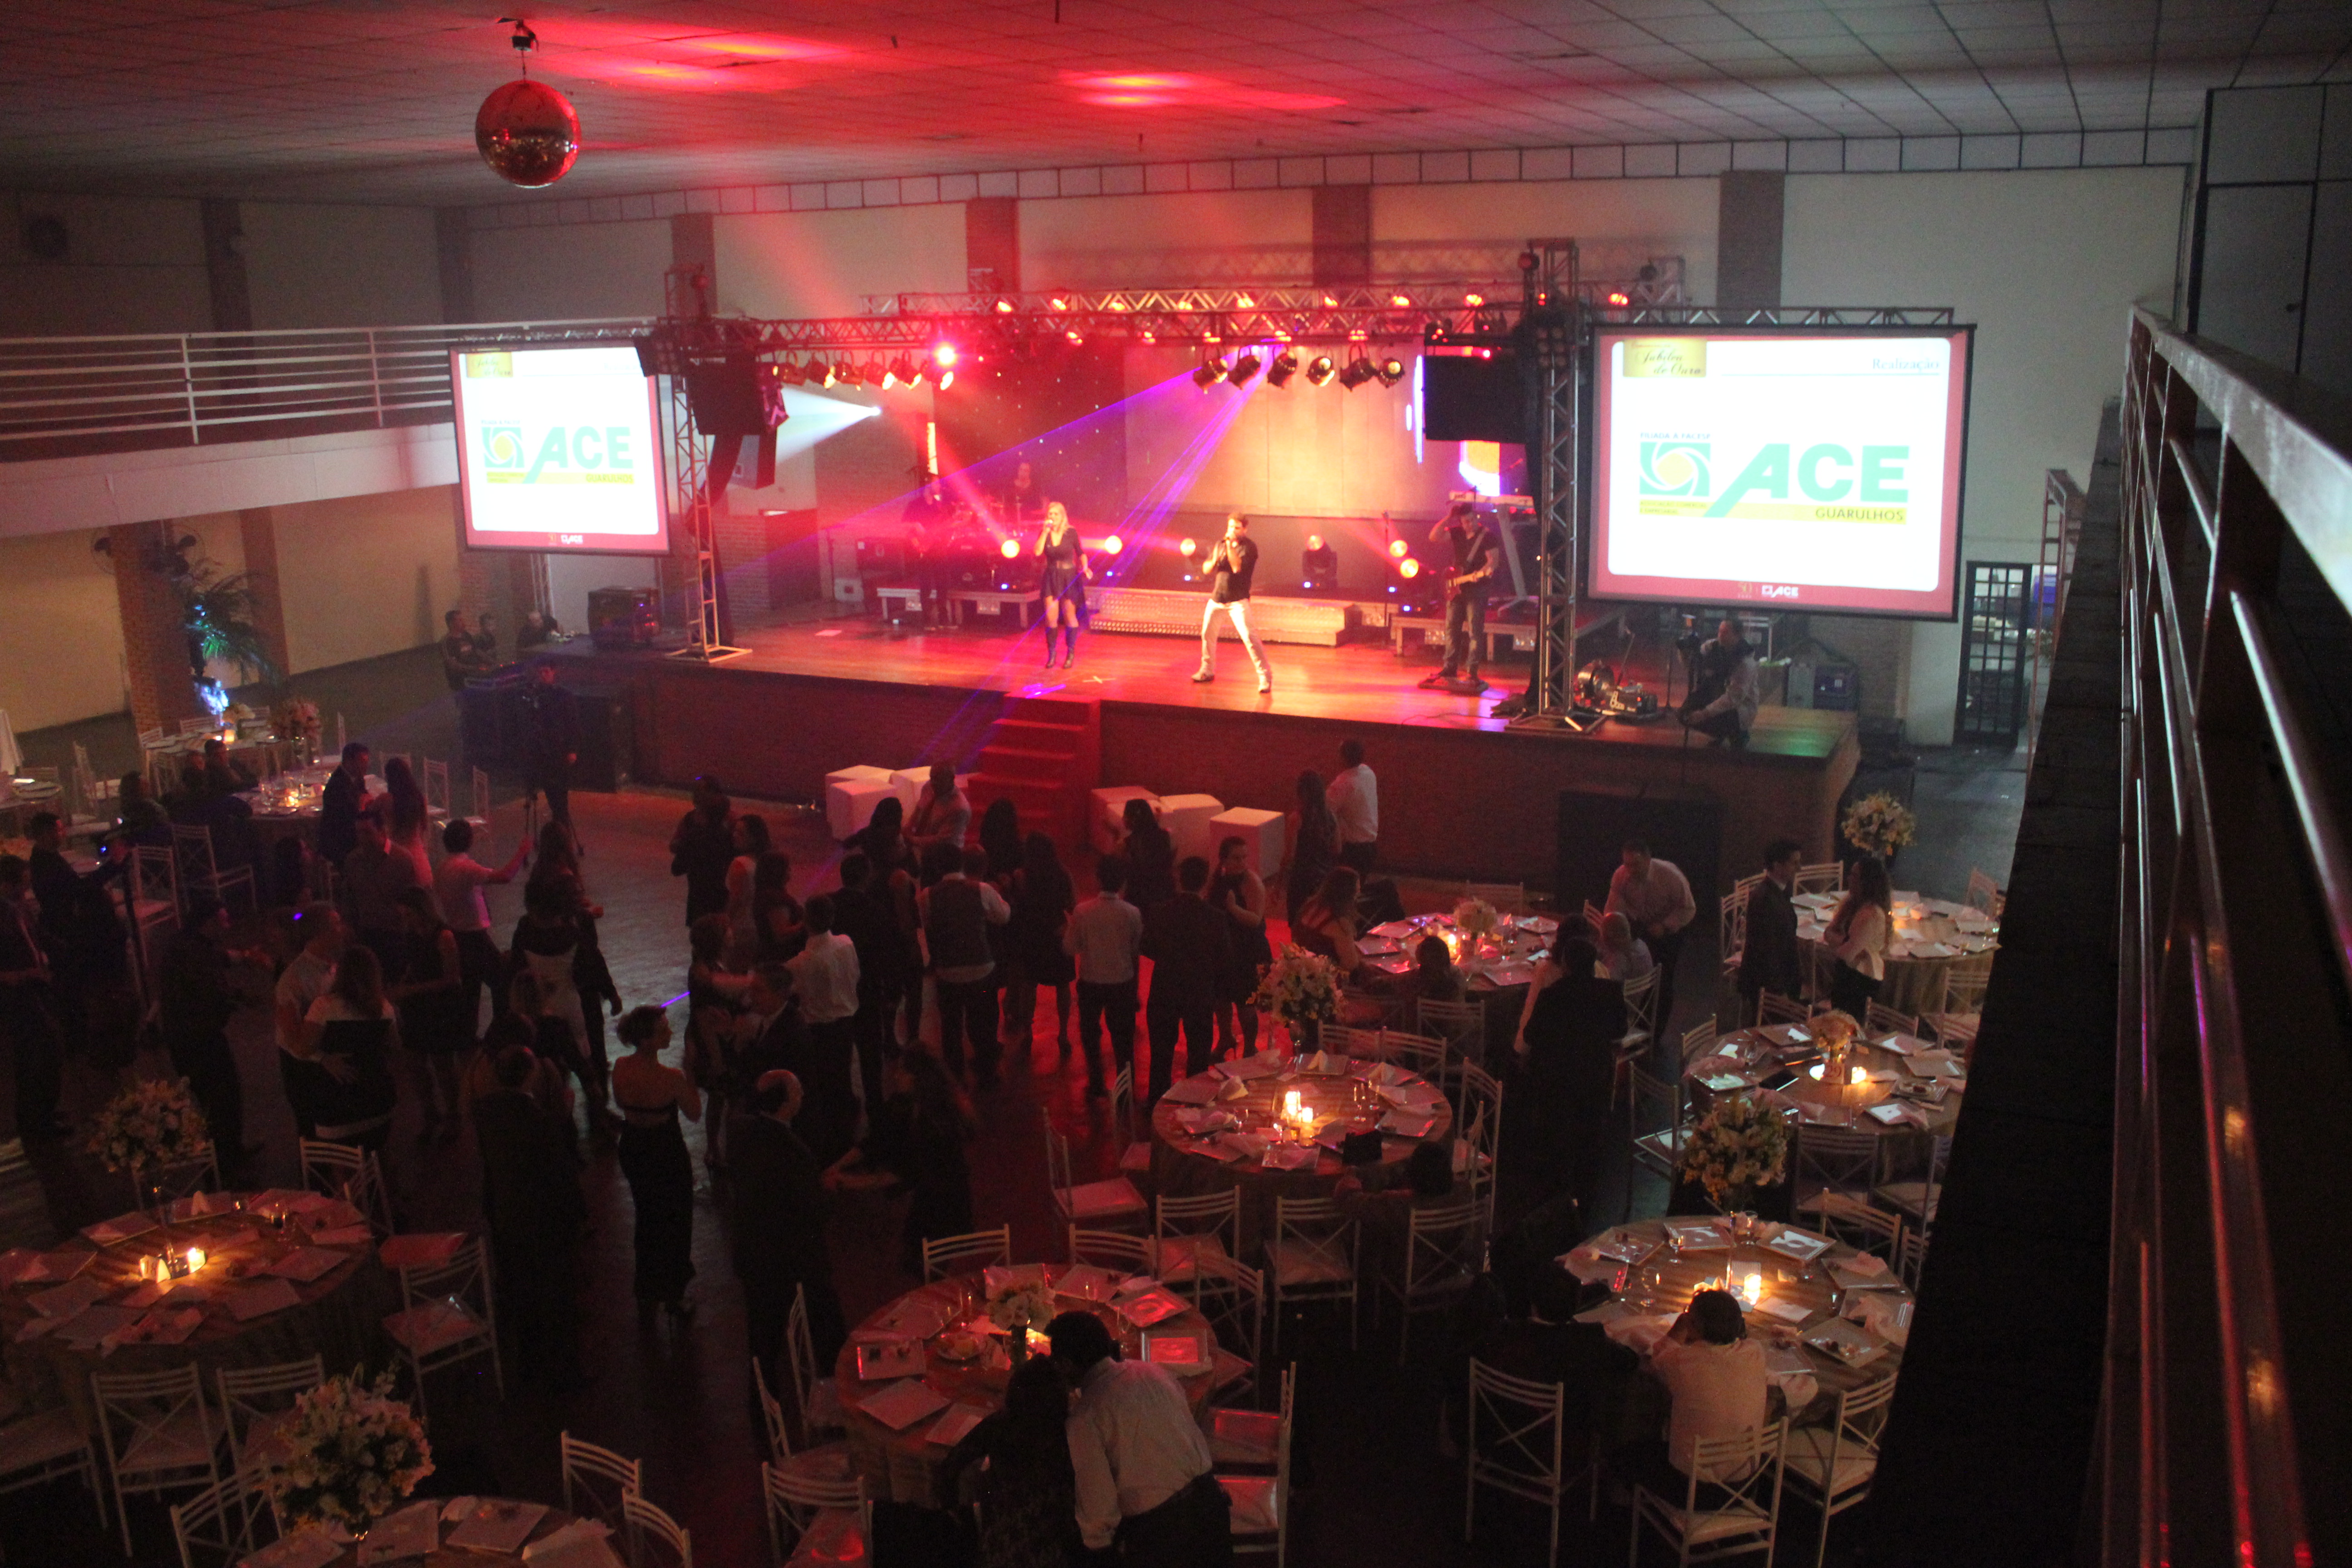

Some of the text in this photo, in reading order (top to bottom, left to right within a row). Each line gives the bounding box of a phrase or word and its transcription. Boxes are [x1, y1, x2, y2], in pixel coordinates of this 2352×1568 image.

[1636, 349, 1683, 364] Jubileu
[1654, 363, 1701, 374] de Ouro
[1873, 358, 1939, 372] Realização
[522, 426, 633, 484] ACE
[586, 473, 634, 484] GUARULHOS
[1703, 443, 1910, 518] ACE
[1815, 507, 1904, 522] GUARULHOS
[1771, 586, 1799, 598] ACE
[1824, 1065, 1842, 1078] 29
